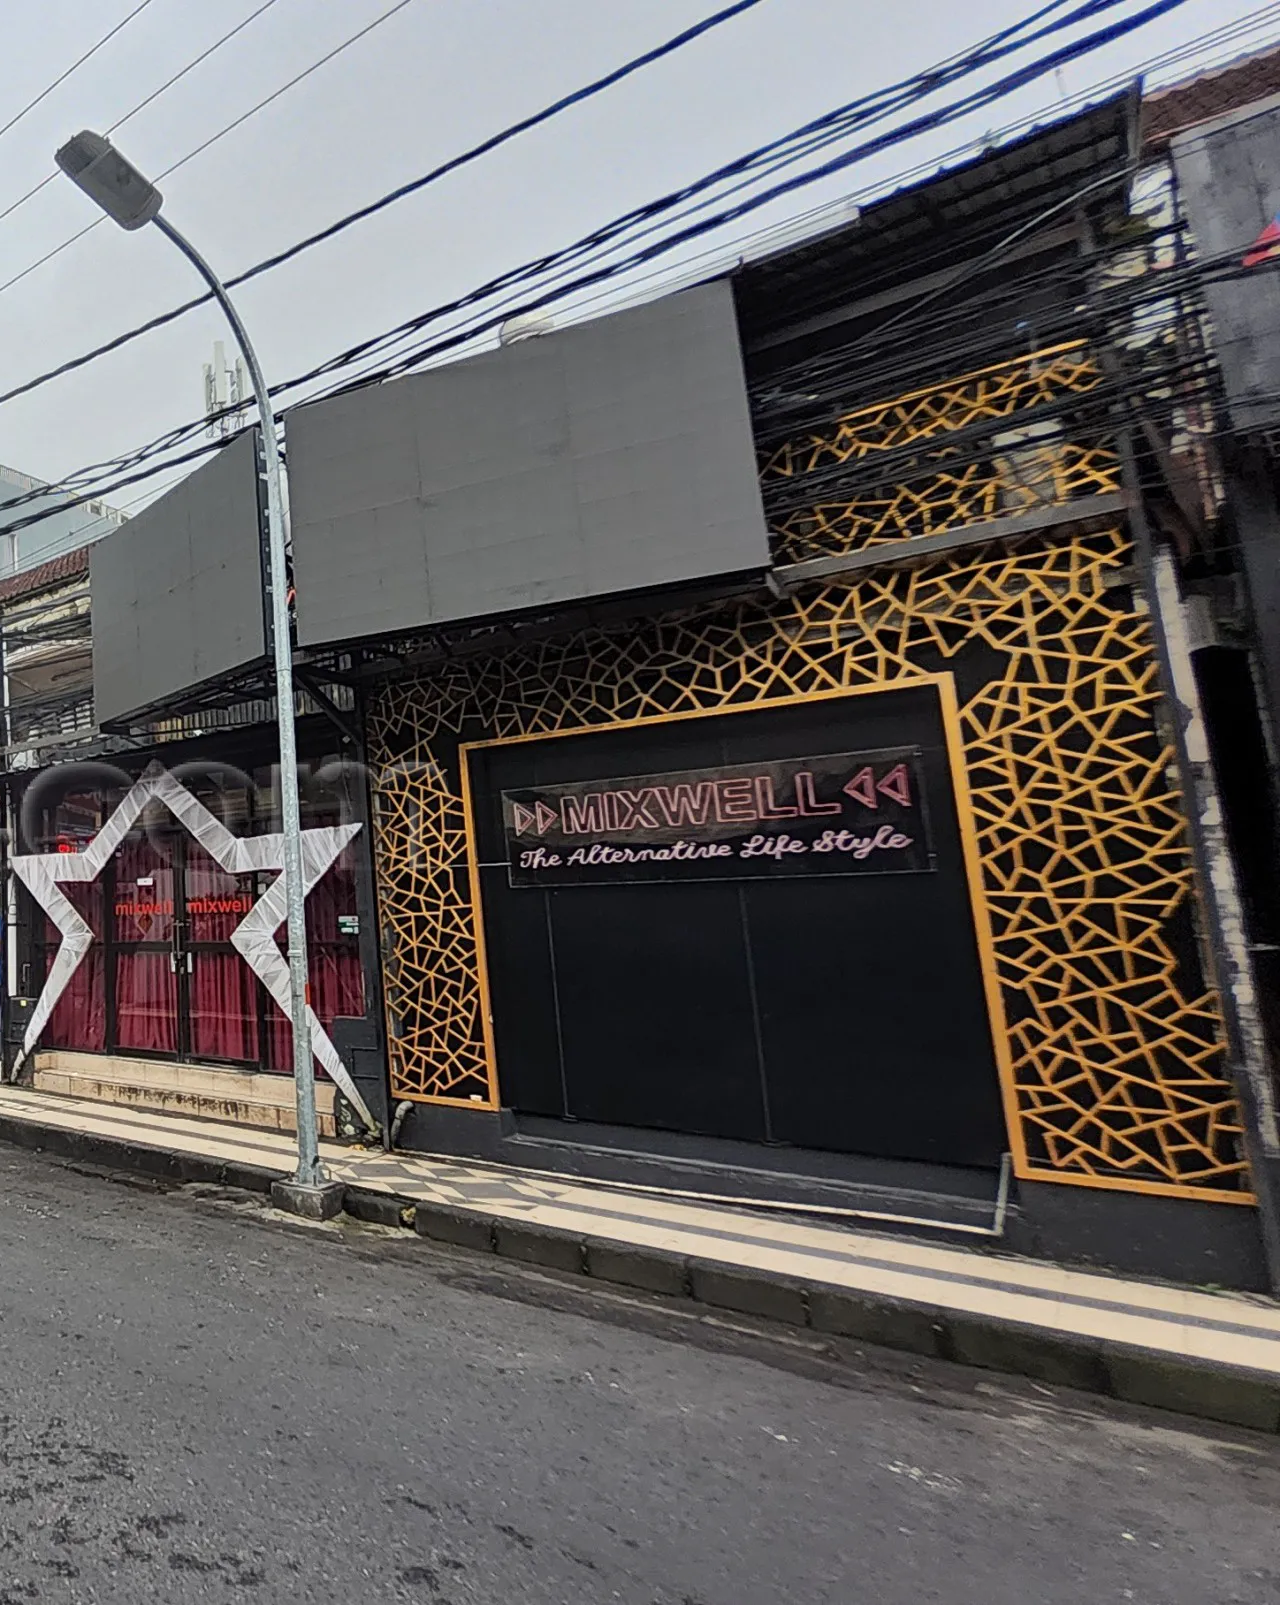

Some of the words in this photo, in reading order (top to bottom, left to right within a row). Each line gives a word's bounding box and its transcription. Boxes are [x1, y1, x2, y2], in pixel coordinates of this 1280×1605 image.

[560, 771, 842, 834] MIXWELL
[520, 847, 562, 868] The
[567, 842, 734, 866] Alternative
[740, 837, 808, 860] Life
[813, 825, 913, 859] Style
[115, 901, 174, 915] mixwell
[186, 896, 253, 913] mixwell
